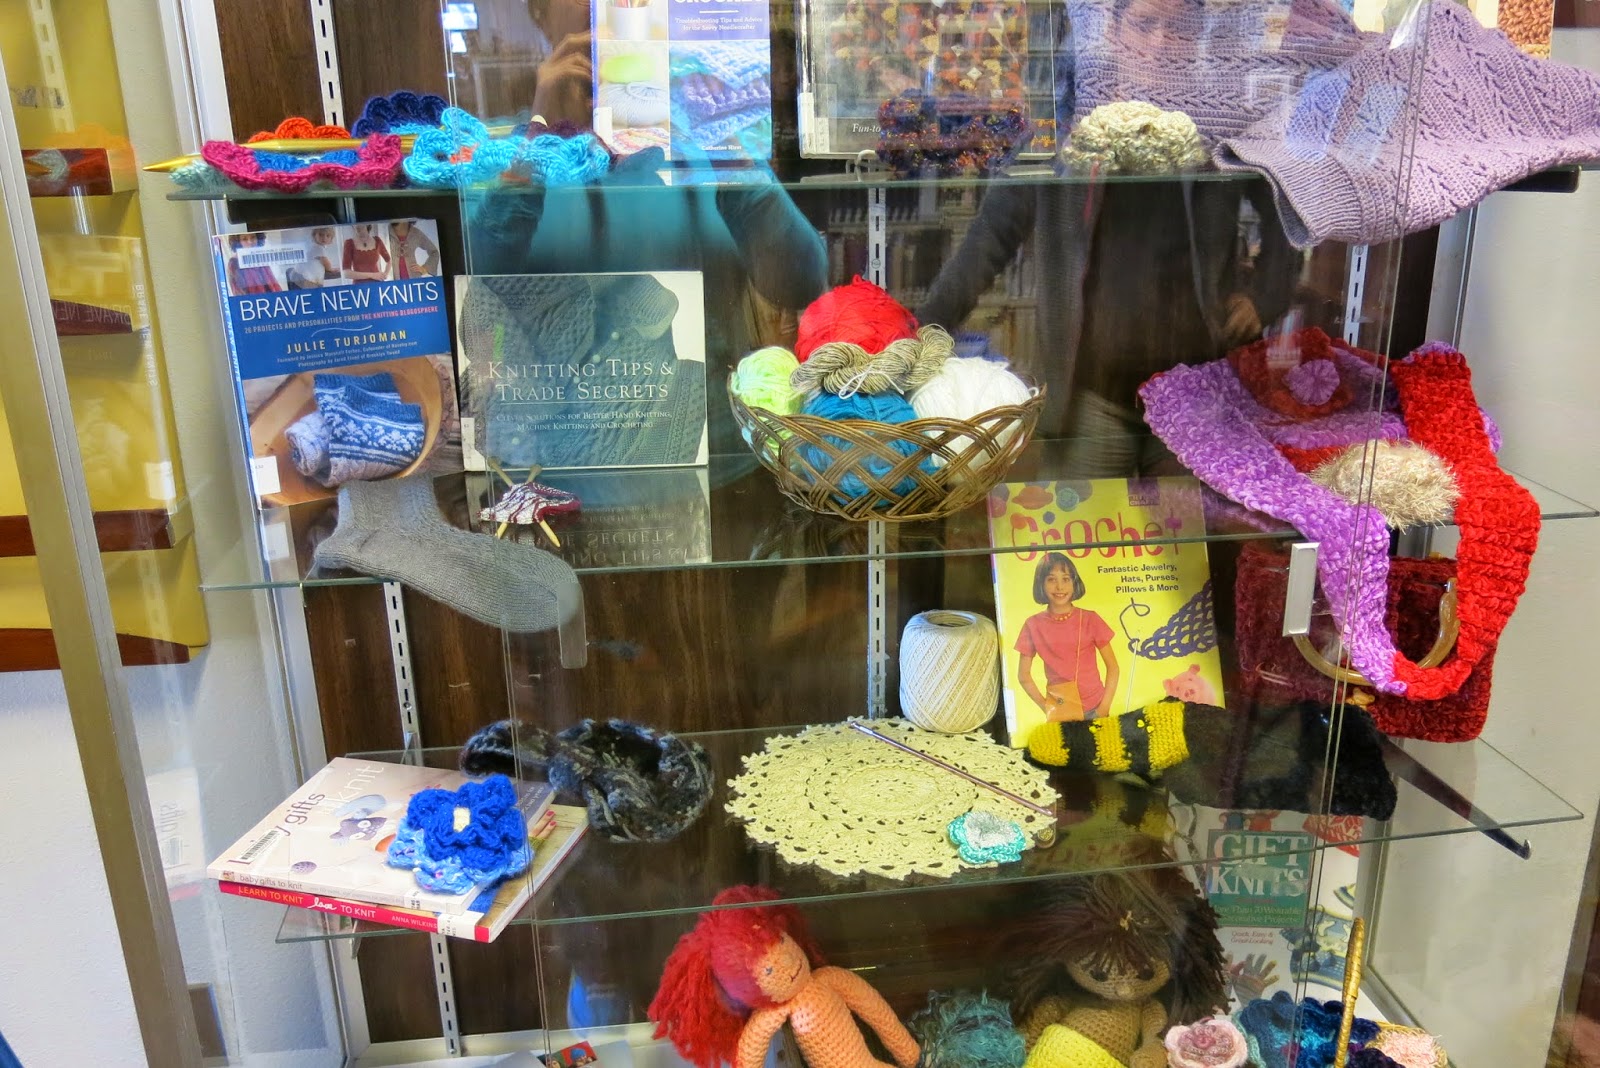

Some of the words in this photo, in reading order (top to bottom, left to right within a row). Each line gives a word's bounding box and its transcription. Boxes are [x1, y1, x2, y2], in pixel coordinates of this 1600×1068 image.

[221, 281, 230, 314] BRAVE
[240, 294, 314, 321] BRAVE
[321, 287, 371, 312] NEW
[378, 281, 439, 305] KNITS
[253, 323, 283, 333] PROJECTS
[284, 322, 297, 330] AND
[298, 316, 343, 328] PERSONALITIES
[344, 314, 360, 323] FROM
[361, 312, 373, 320] THE
[373, 310, 399, 319] KNITTING
[400, 305, 439, 317] BLOGOSPHERE
[286, 340, 326, 354] JULIE
[334, 330, 407, 348] TURJOMAN
[488, 361, 596, 379] KNITTING
[605, 358, 652, 377] TIPS
[660, 361, 674, 375] &
[494, 384, 566, 401] TRADE
[577, 381, 669, 400] SECRETS
[526, 413, 566, 421] SOLUTIONS
[583, 411, 609, 420] BETTER
[611, 411, 634, 419] HAND
[553, 422, 589, 430] KNITTING
[607, 421, 654, 429] CROCHETING
[1097, 564, 1139, 574] Fantastic
[1141, 563, 1177, 573] Jewelry,
[1121, 574, 1144, 583] Hats,
[1146, 573, 1178, 582] Purses,
[1116, 585, 1147, 594] Pillows
[1149, 585, 1155, 593] &
[1156, 583, 1179, 592] More
[339, 765, 384, 799] knit
[285, 793, 325, 825] gifts
[1214, 834, 1308, 866] GIFT
[240, 873, 259, 885] baby
[260, 876, 276, 887] gifts
[278, 879, 286, 887] to
[288, 881, 303, 890] knit
[1209, 866, 1304, 897] KNITS
[238, 886, 268, 898] LEARN
[269, 888, 281, 900] TO
[282, 891, 304, 904] KNIT
[341, 904, 353, 914] TO
[354, 906, 376, 918] KNIT
[391, 915, 409, 924] ANNA
[410, 918, 437, 929] WILKINS
